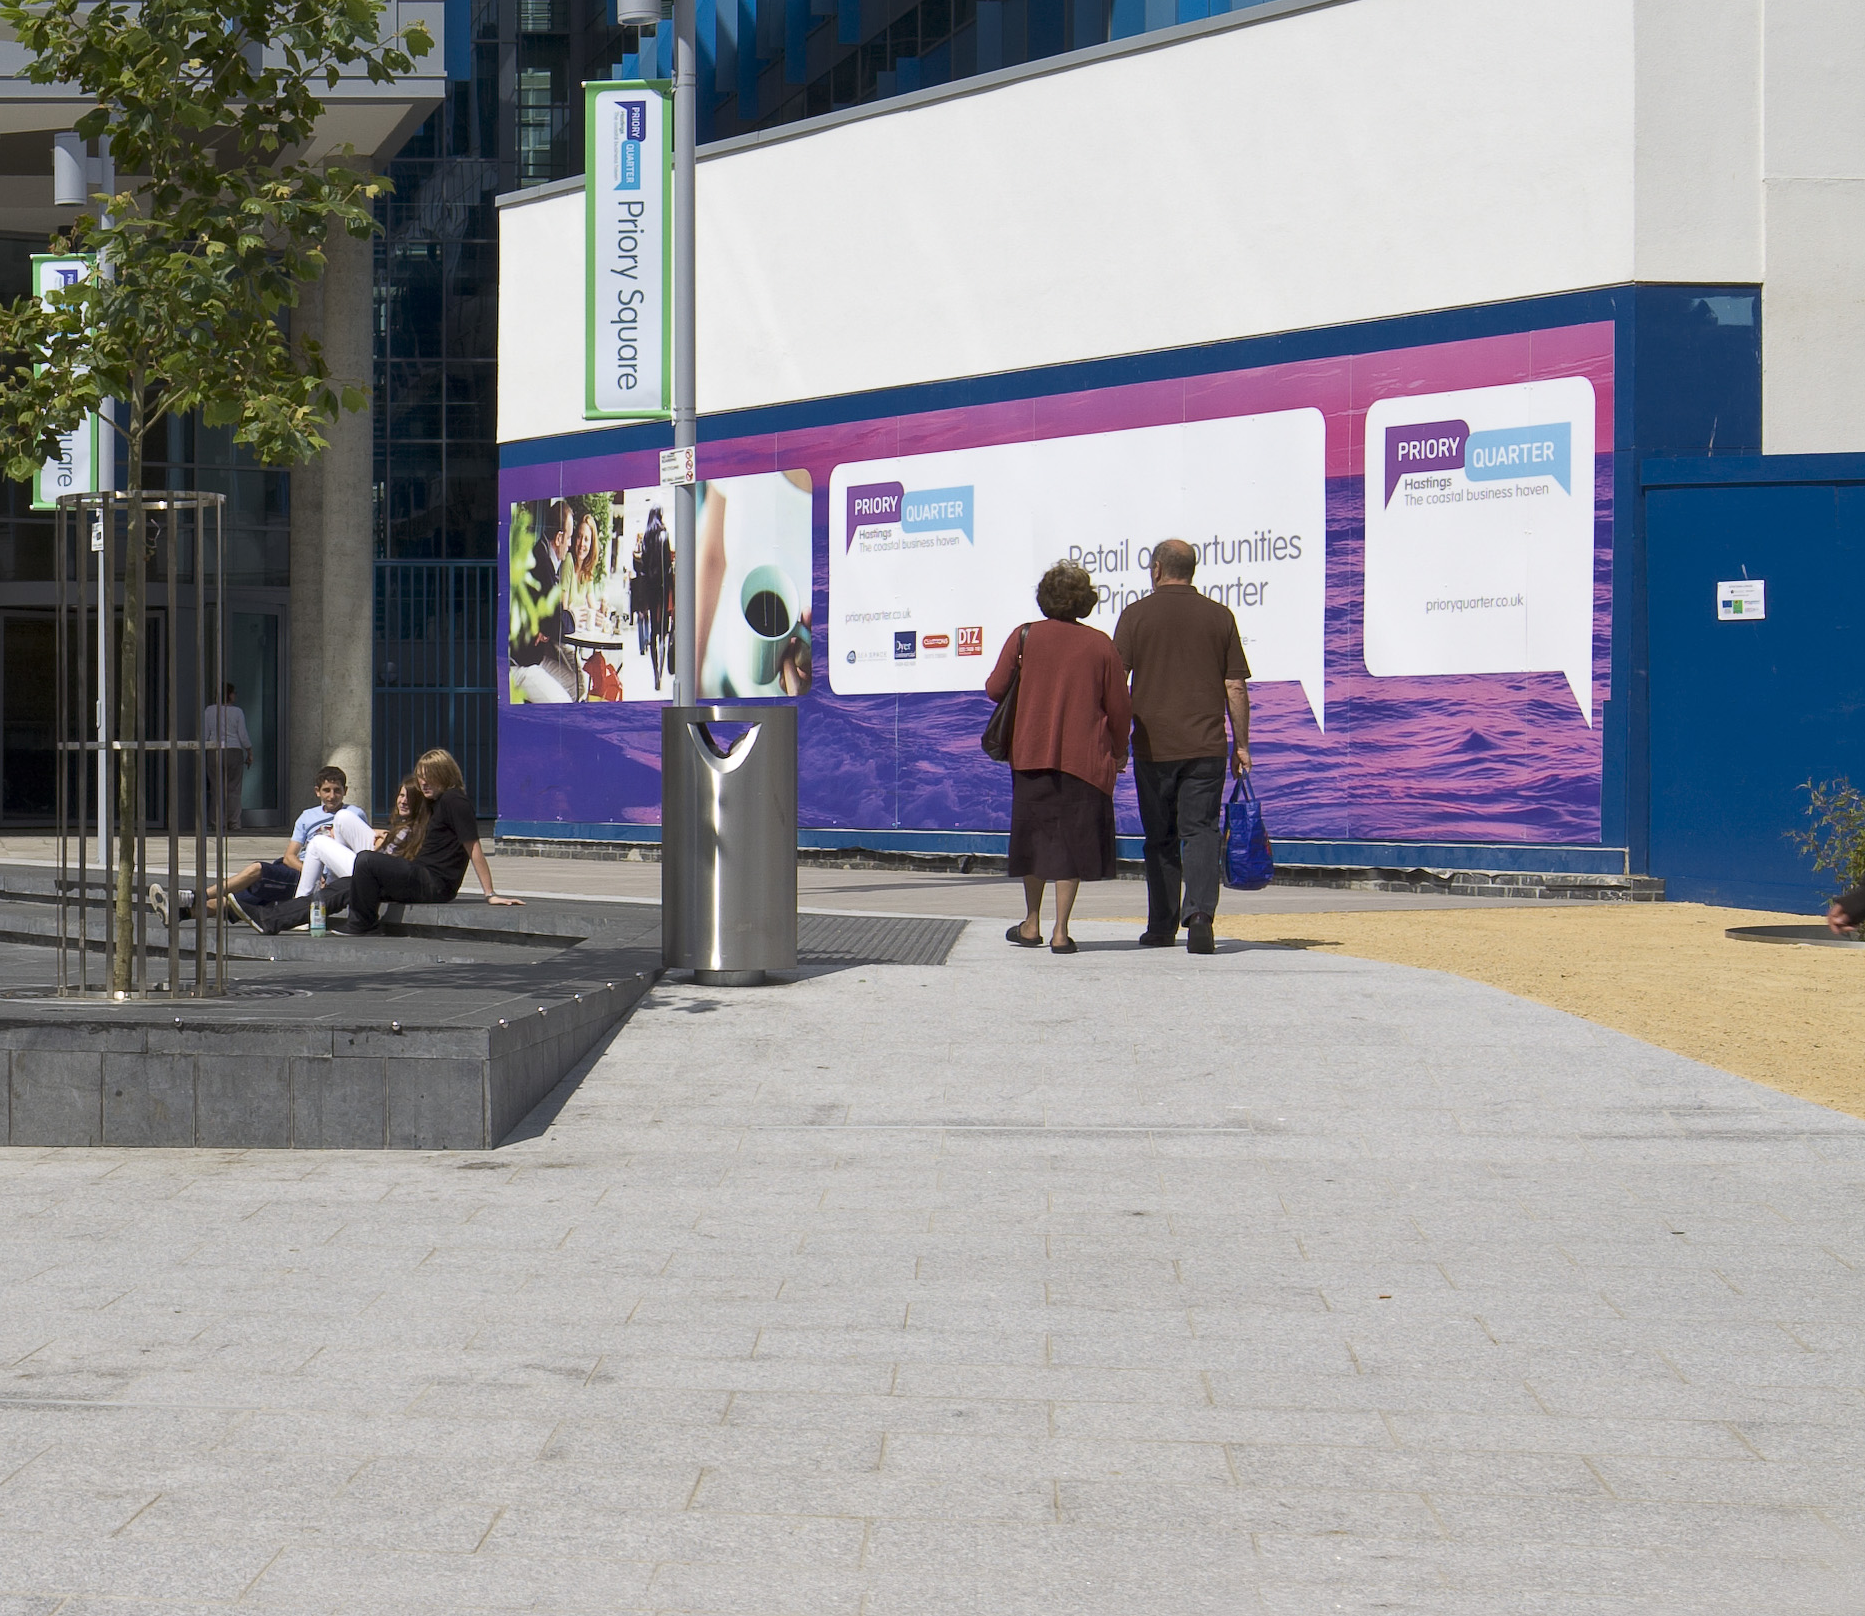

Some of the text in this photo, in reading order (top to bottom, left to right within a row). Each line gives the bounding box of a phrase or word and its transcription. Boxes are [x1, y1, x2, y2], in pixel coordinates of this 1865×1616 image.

[625, 107, 641, 184] PRIORY QUARTER
[610, 201, 645, 391] Priory Square
[1397, 436, 1555, 469] PRIORY QUARTER
[1404, 476, 1453, 491] Hastings
[1404, 483, 1550, 507] The coastal business haven
[854, 495, 964, 523] PRIORY QUARTER
[859, 528, 892, 541] Hastings
[859, 535, 960, 554] The coastal business haven
[1069, 529, 1302, 574] Retail oortunities
[1425, 592, 1524, 615] prioryquarter.co.uk
[845, 607, 912, 625] prioryquarter.co.uk
[958, 628, 980, 645] DTZ
